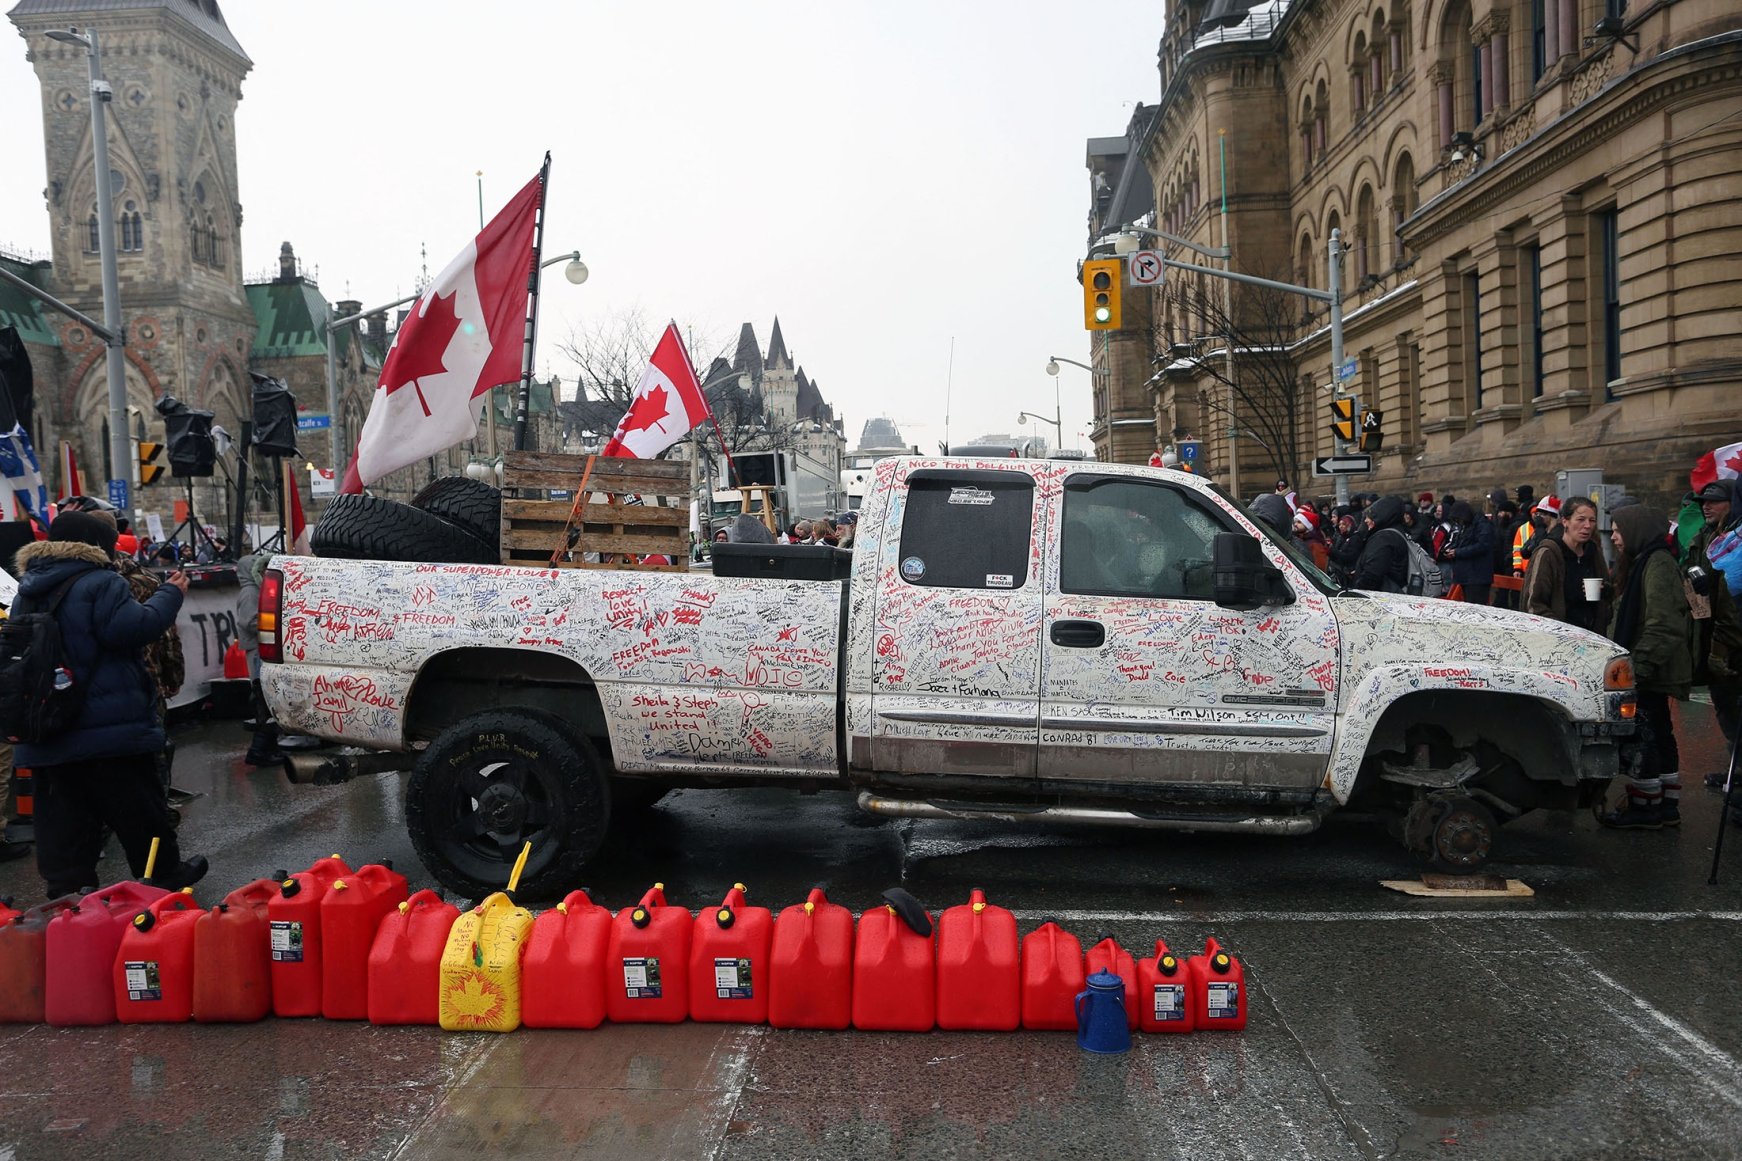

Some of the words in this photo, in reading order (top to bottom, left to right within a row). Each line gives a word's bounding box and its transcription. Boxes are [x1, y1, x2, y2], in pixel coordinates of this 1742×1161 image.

[976, 462, 1025, 470] BELGIUM
[416, 564, 437, 573] OUR
[950, 597, 993, 609] FREEDOM
[1136, 601, 1169, 609] PEACE
[402, 613, 455, 624] FREEDOM
[748, 643, 780, 652] CANADA
[1424, 666, 1472, 677] FREEDOM!
[632, 695, 669, 707] Sheila
[682, 695, 718, 710] Steph
[666, 709, 706, 719] stand
[1167, 708, 1192, 718] Tim
[1195, 708, 1236, 722] Wilson
